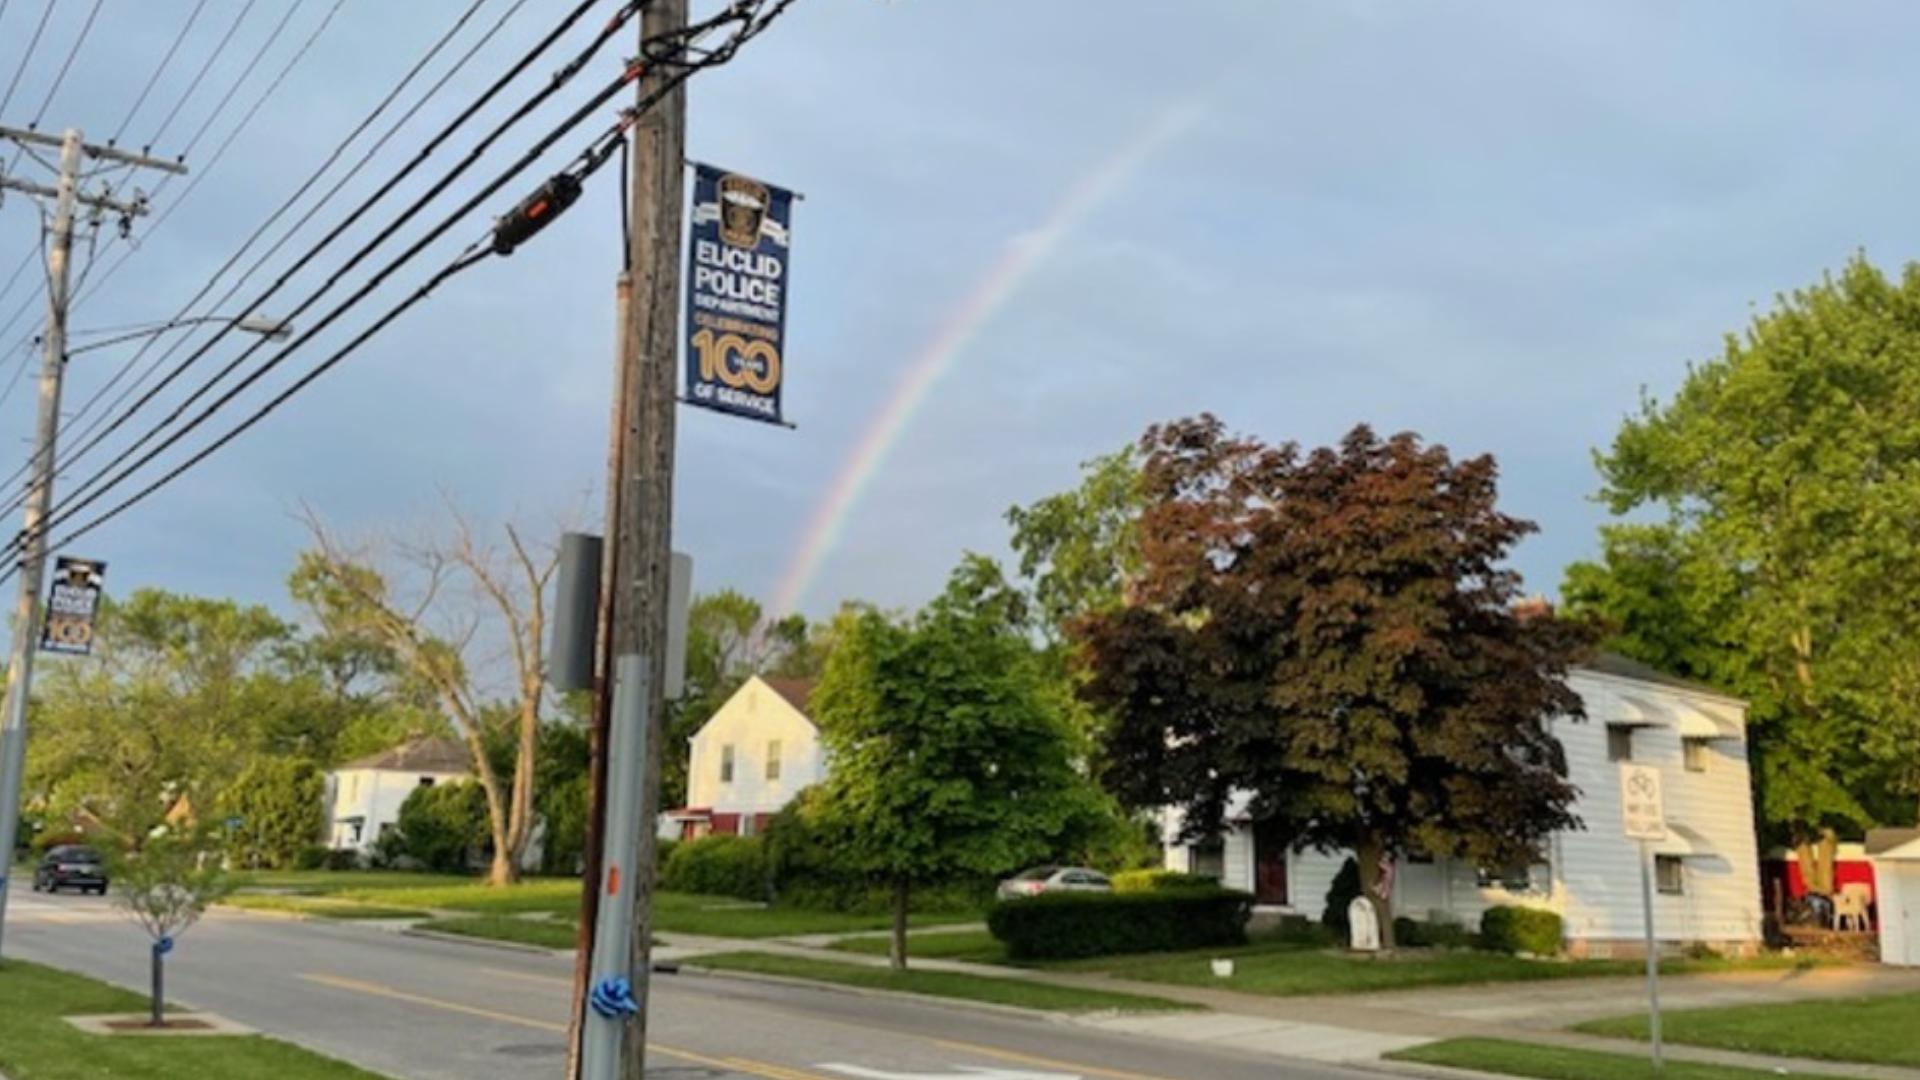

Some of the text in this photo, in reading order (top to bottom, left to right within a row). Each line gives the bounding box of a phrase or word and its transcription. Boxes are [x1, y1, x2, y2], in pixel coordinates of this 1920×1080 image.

[695, 239, 782, 279] EUCLID
[694, 266, 780, 306] POLICE
[690, 328, 780, 394] 100
[694, 382, 776, 414] OF SERVICE
